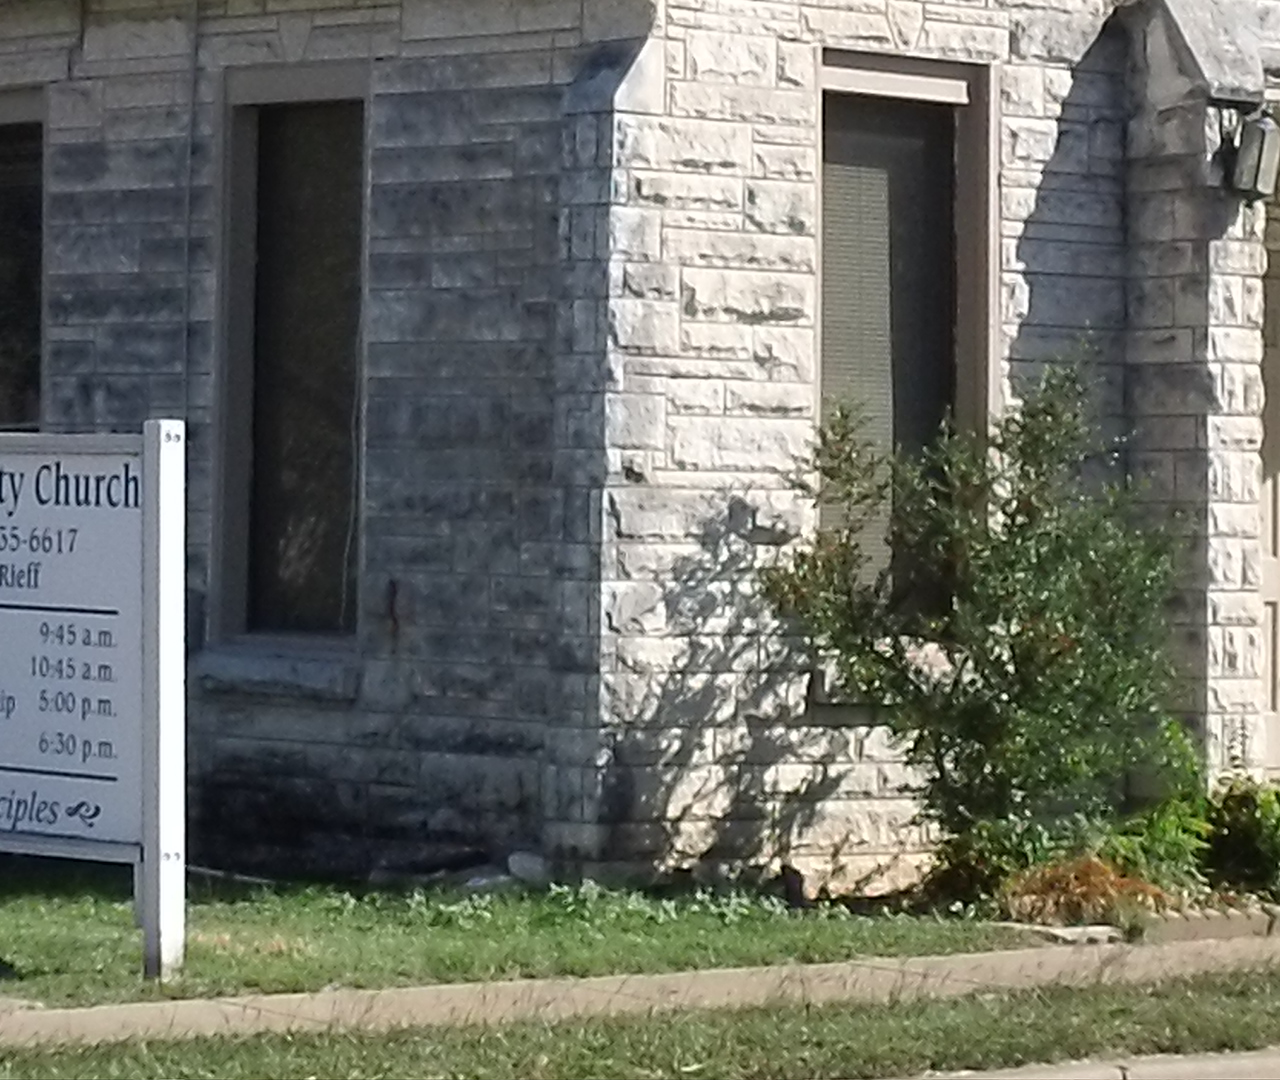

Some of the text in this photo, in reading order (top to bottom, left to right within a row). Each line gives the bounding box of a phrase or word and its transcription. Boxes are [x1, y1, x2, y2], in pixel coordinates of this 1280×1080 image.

[35, 462, 141, 508] Church
[40, 622, 76, 646] 9:45
[82, 628, 117, 648] a.m.
[31, 656, 75, 680] 10:45
[82, 663, 117, 682] a.m.
[39, 689, 75, 714] 5:00
[81, 697, 117, 720] p.m.
[39, 732, 76, 756] 6:30
[82, 739, 118, 763] p.m.
